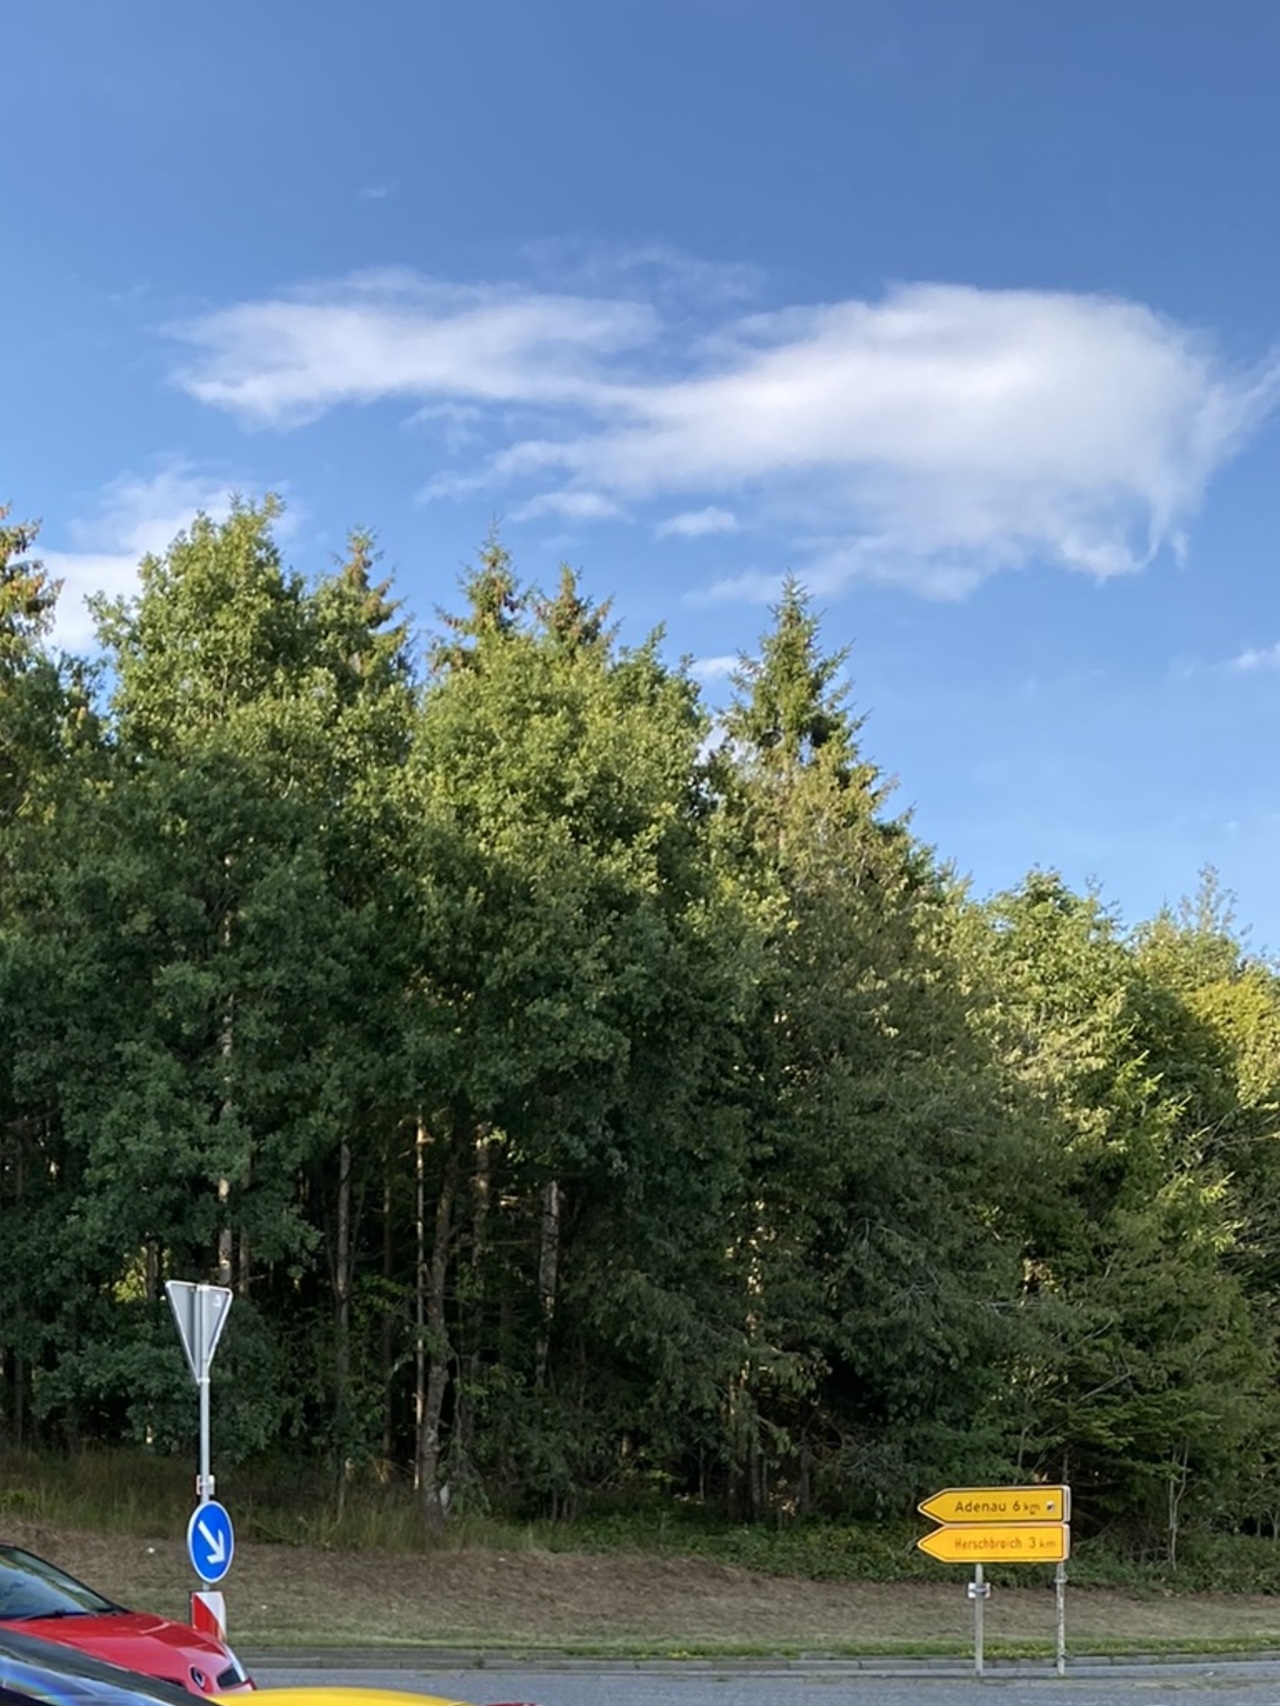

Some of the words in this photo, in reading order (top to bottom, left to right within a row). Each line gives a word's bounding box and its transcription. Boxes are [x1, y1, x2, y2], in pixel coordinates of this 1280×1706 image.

[954, 1501, 1007, 1513] Adenau
[1012, 1500, 1021, 1512] 6
[1023, 1502, 1041, 1512] km
[1028, 1536, 1037, 1549] 3
[1039, 1538, 1056, 1549] km
